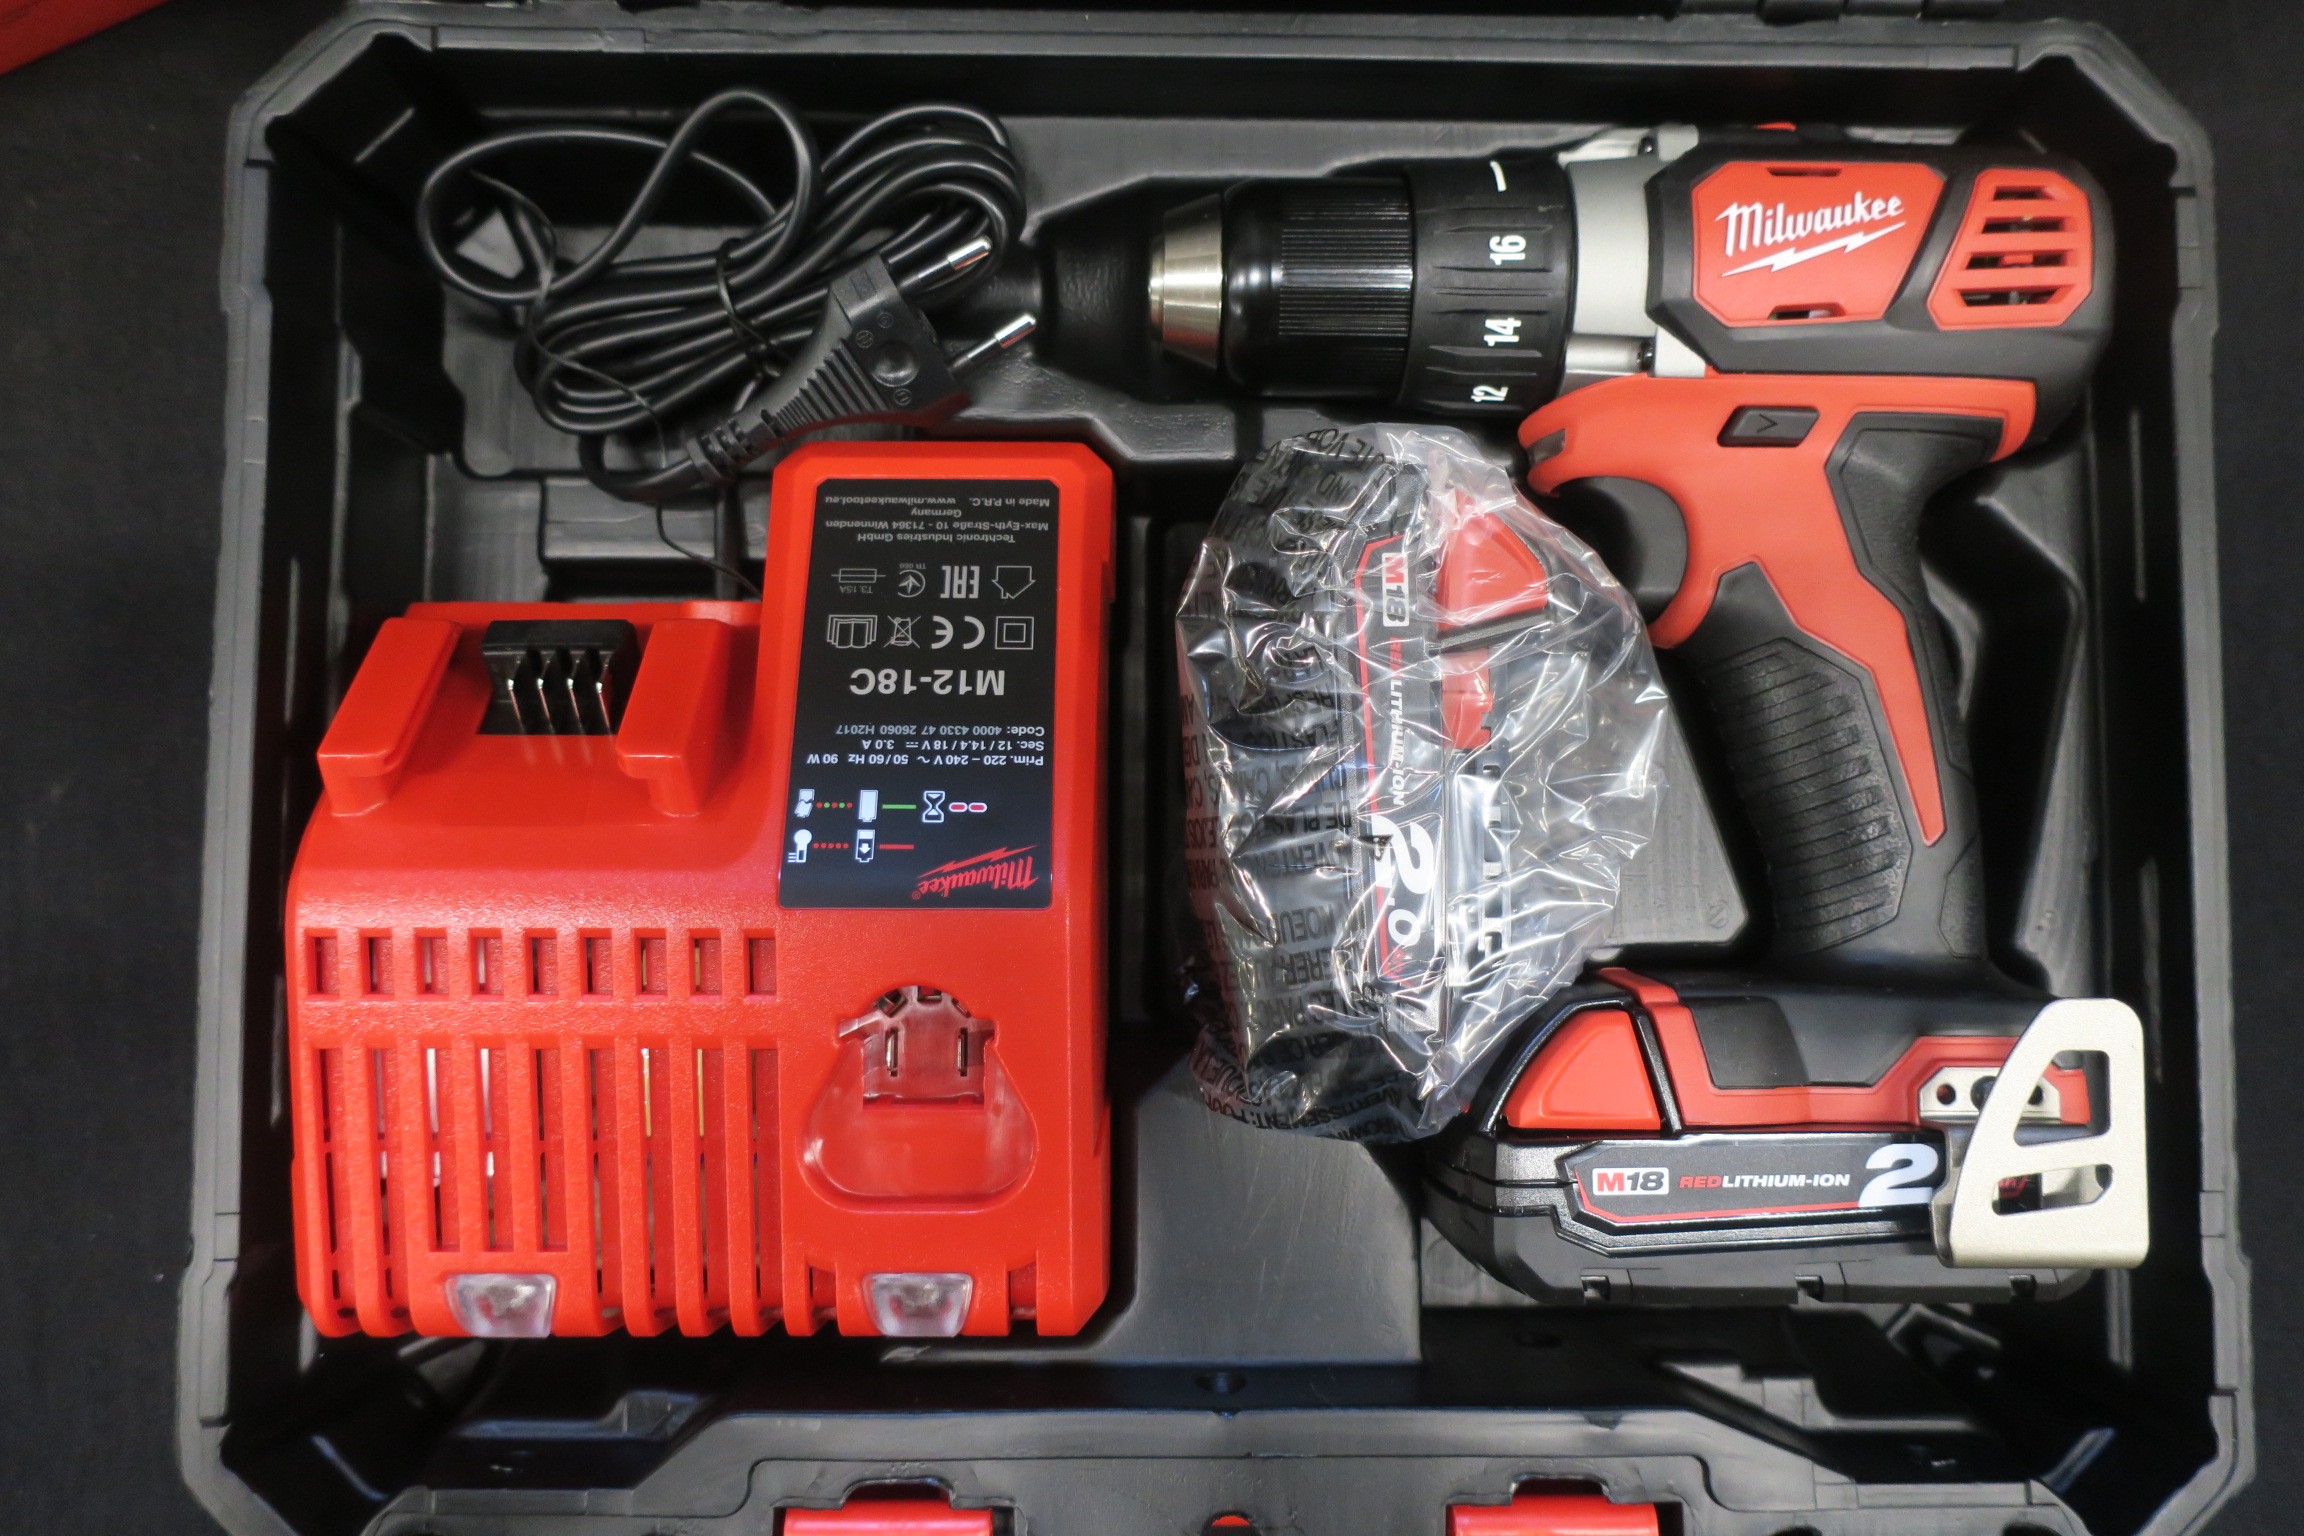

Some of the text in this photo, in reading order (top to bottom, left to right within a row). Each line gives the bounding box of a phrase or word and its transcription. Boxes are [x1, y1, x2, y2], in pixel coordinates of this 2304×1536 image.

[1715, 191, 1904, 257] Milwaukee
[1489, 235, 1527, 266] 16
[1484, 317, 1522, 347] 14
[1471, 385, 1509, 402] 12
[825, 496, 1050, 507] Made in P.R.C. www.milwaukeetool.eu
[910, 507, 962, 518] Germany
[825, 520, 889, 530] Winnenden
[892, 521, 925, 530] 71364
[936, 521, 949, 530] 10
[952, 520, 1048, 531] Max-Eyth-Straße
[857, 533, 1016, 543] Techtronic Industries GmbH
[1384, 555, 1406, 624] M18
[850, 668, 1005, 696] M12-18C
[836, 724, 1045, 737] Code: 4000 4330 47 26060 H2017
[862, 740, 872, 750] A
[875, 739, 895, 750] 3.0
[921, 740, 931, 750] V
[933, 740, 948, 750] 18
[960, 740, 986, 750] 14.4
[998, 740, 1012, 751] 12
[1016, 740, 1044, 752] Sec.
[806, 754, 819, 764] W
[822, 754, 838, 764] 90
[848, 754, 865, 764] Hz
[933, 755, 943, 765] V
[945, 754, 969, 765] 240
[983, 755, 1007, 766] 220
[1010, 755, 1044, 766] Prim.
[917, 855, 1039, 897] Milwaukee
[1596, 1171, 1668, 1193] M18
[1679, 1172, 1851, 1189] REDLITHIUM-ION
